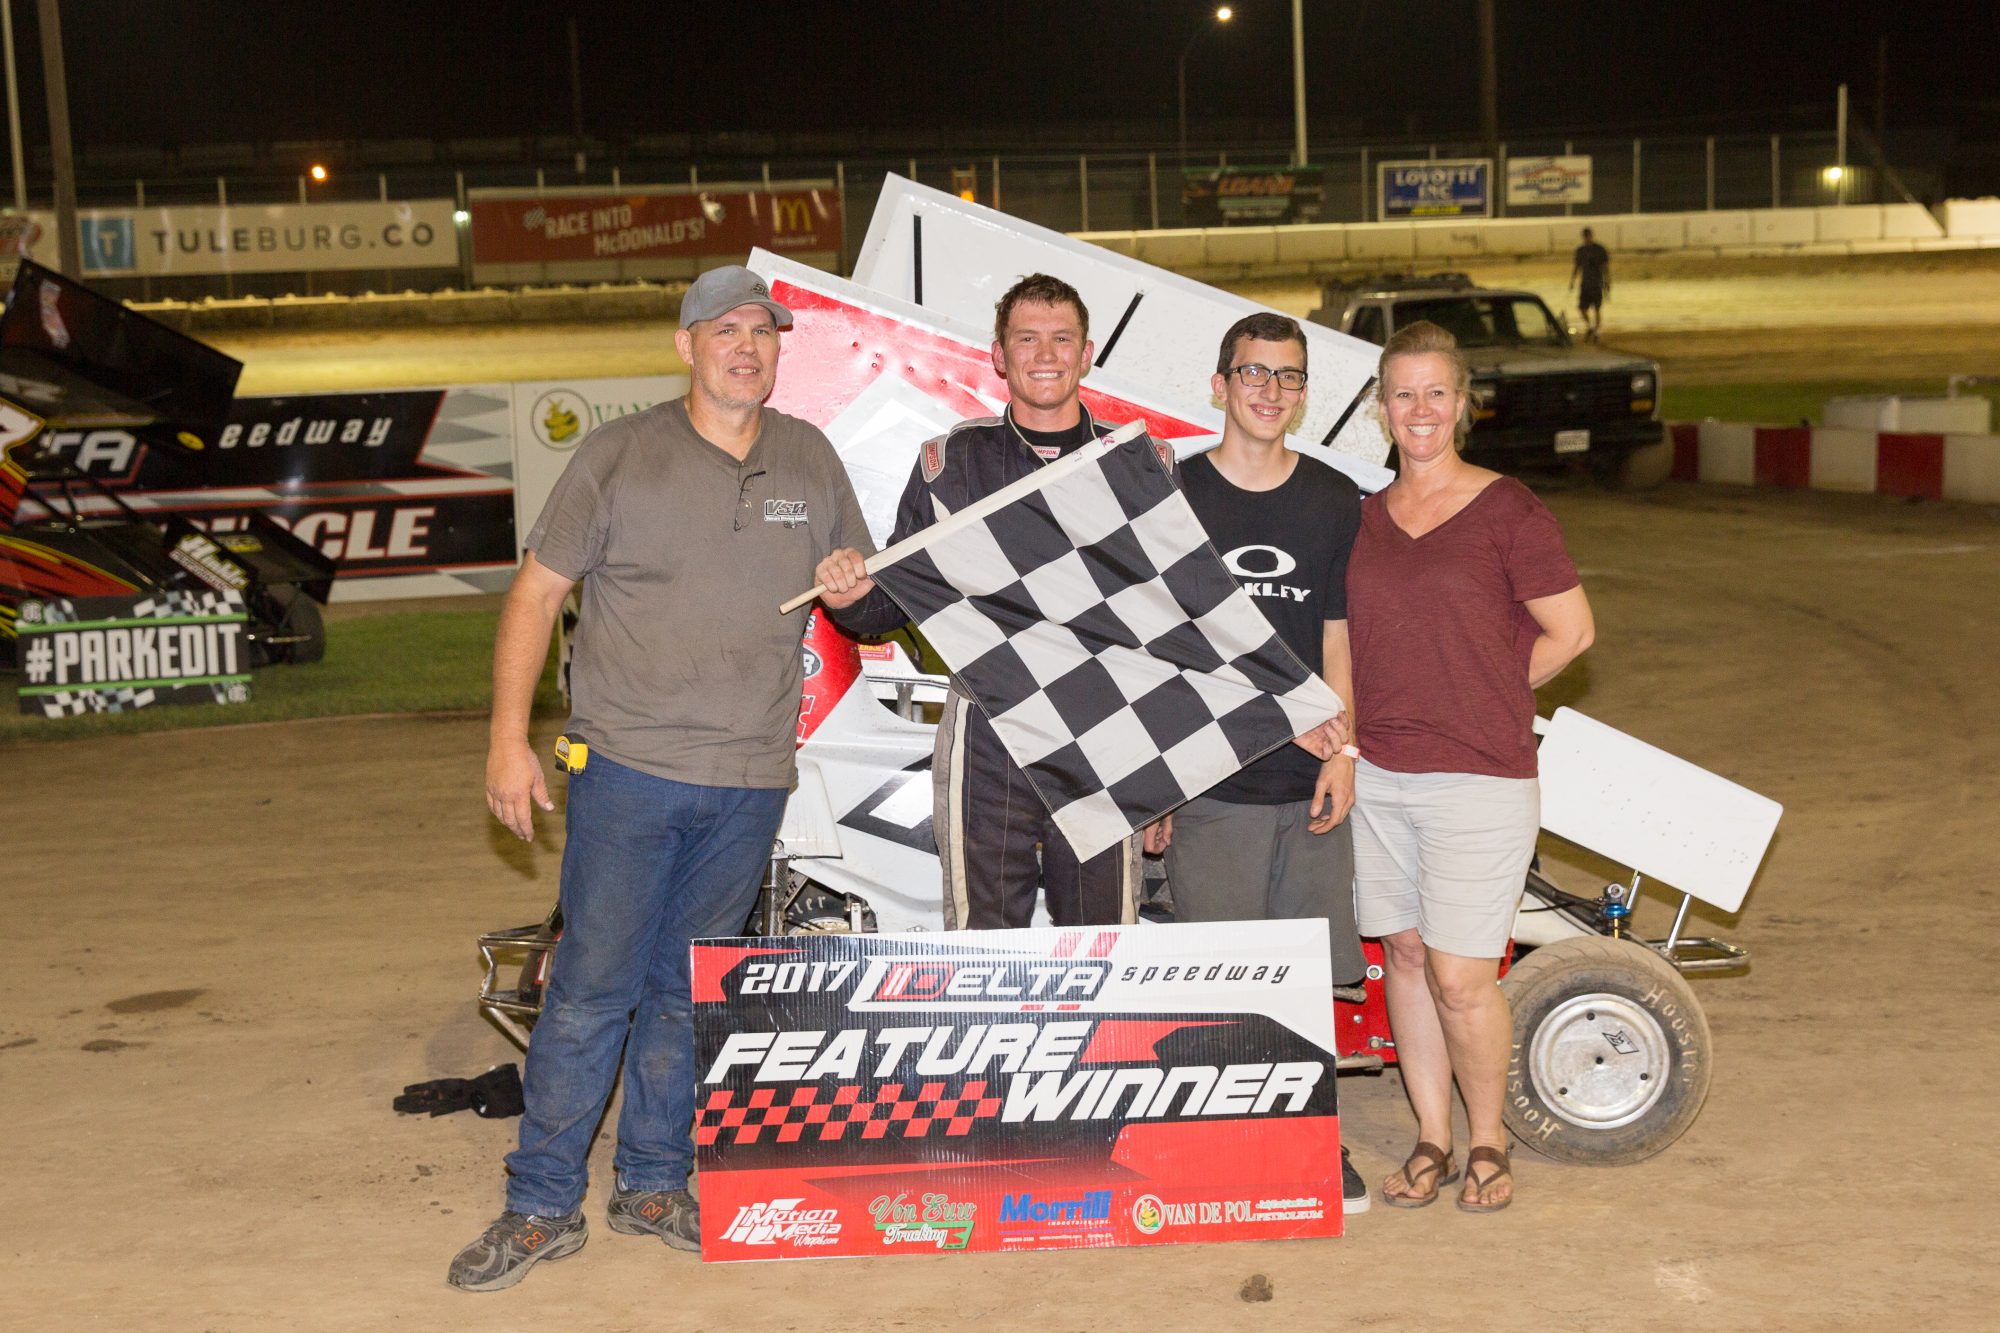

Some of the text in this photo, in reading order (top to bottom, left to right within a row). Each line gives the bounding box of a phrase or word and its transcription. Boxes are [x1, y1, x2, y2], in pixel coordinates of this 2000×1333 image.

[152, 222, 434, 253] TULEBURG.CO
[546, 204, 633, 240] RACE INTO
[218, 416, 392, 449] eedway
[1243, 582, 1311, 602] KLEY
[25, 623, 242, 685] #PARKEDIT
[740, 960, 1292, 1000] 2017 DELTA speedway
[703, 1020, 1095, 1085] FEATURE
[1001, 1061, 1323, 1123] WINNER
[868, 1192, 977, 1224] Von Euw
[999, 1190, 1113, 1222] Morrill
[1164, 1203, 1196, 1225] VAN
[1199, 1202, 1222, 1224] DE
[1224, 1200, 1254, 1222] POL
[883, 1223, 949, 1249] Trucking
